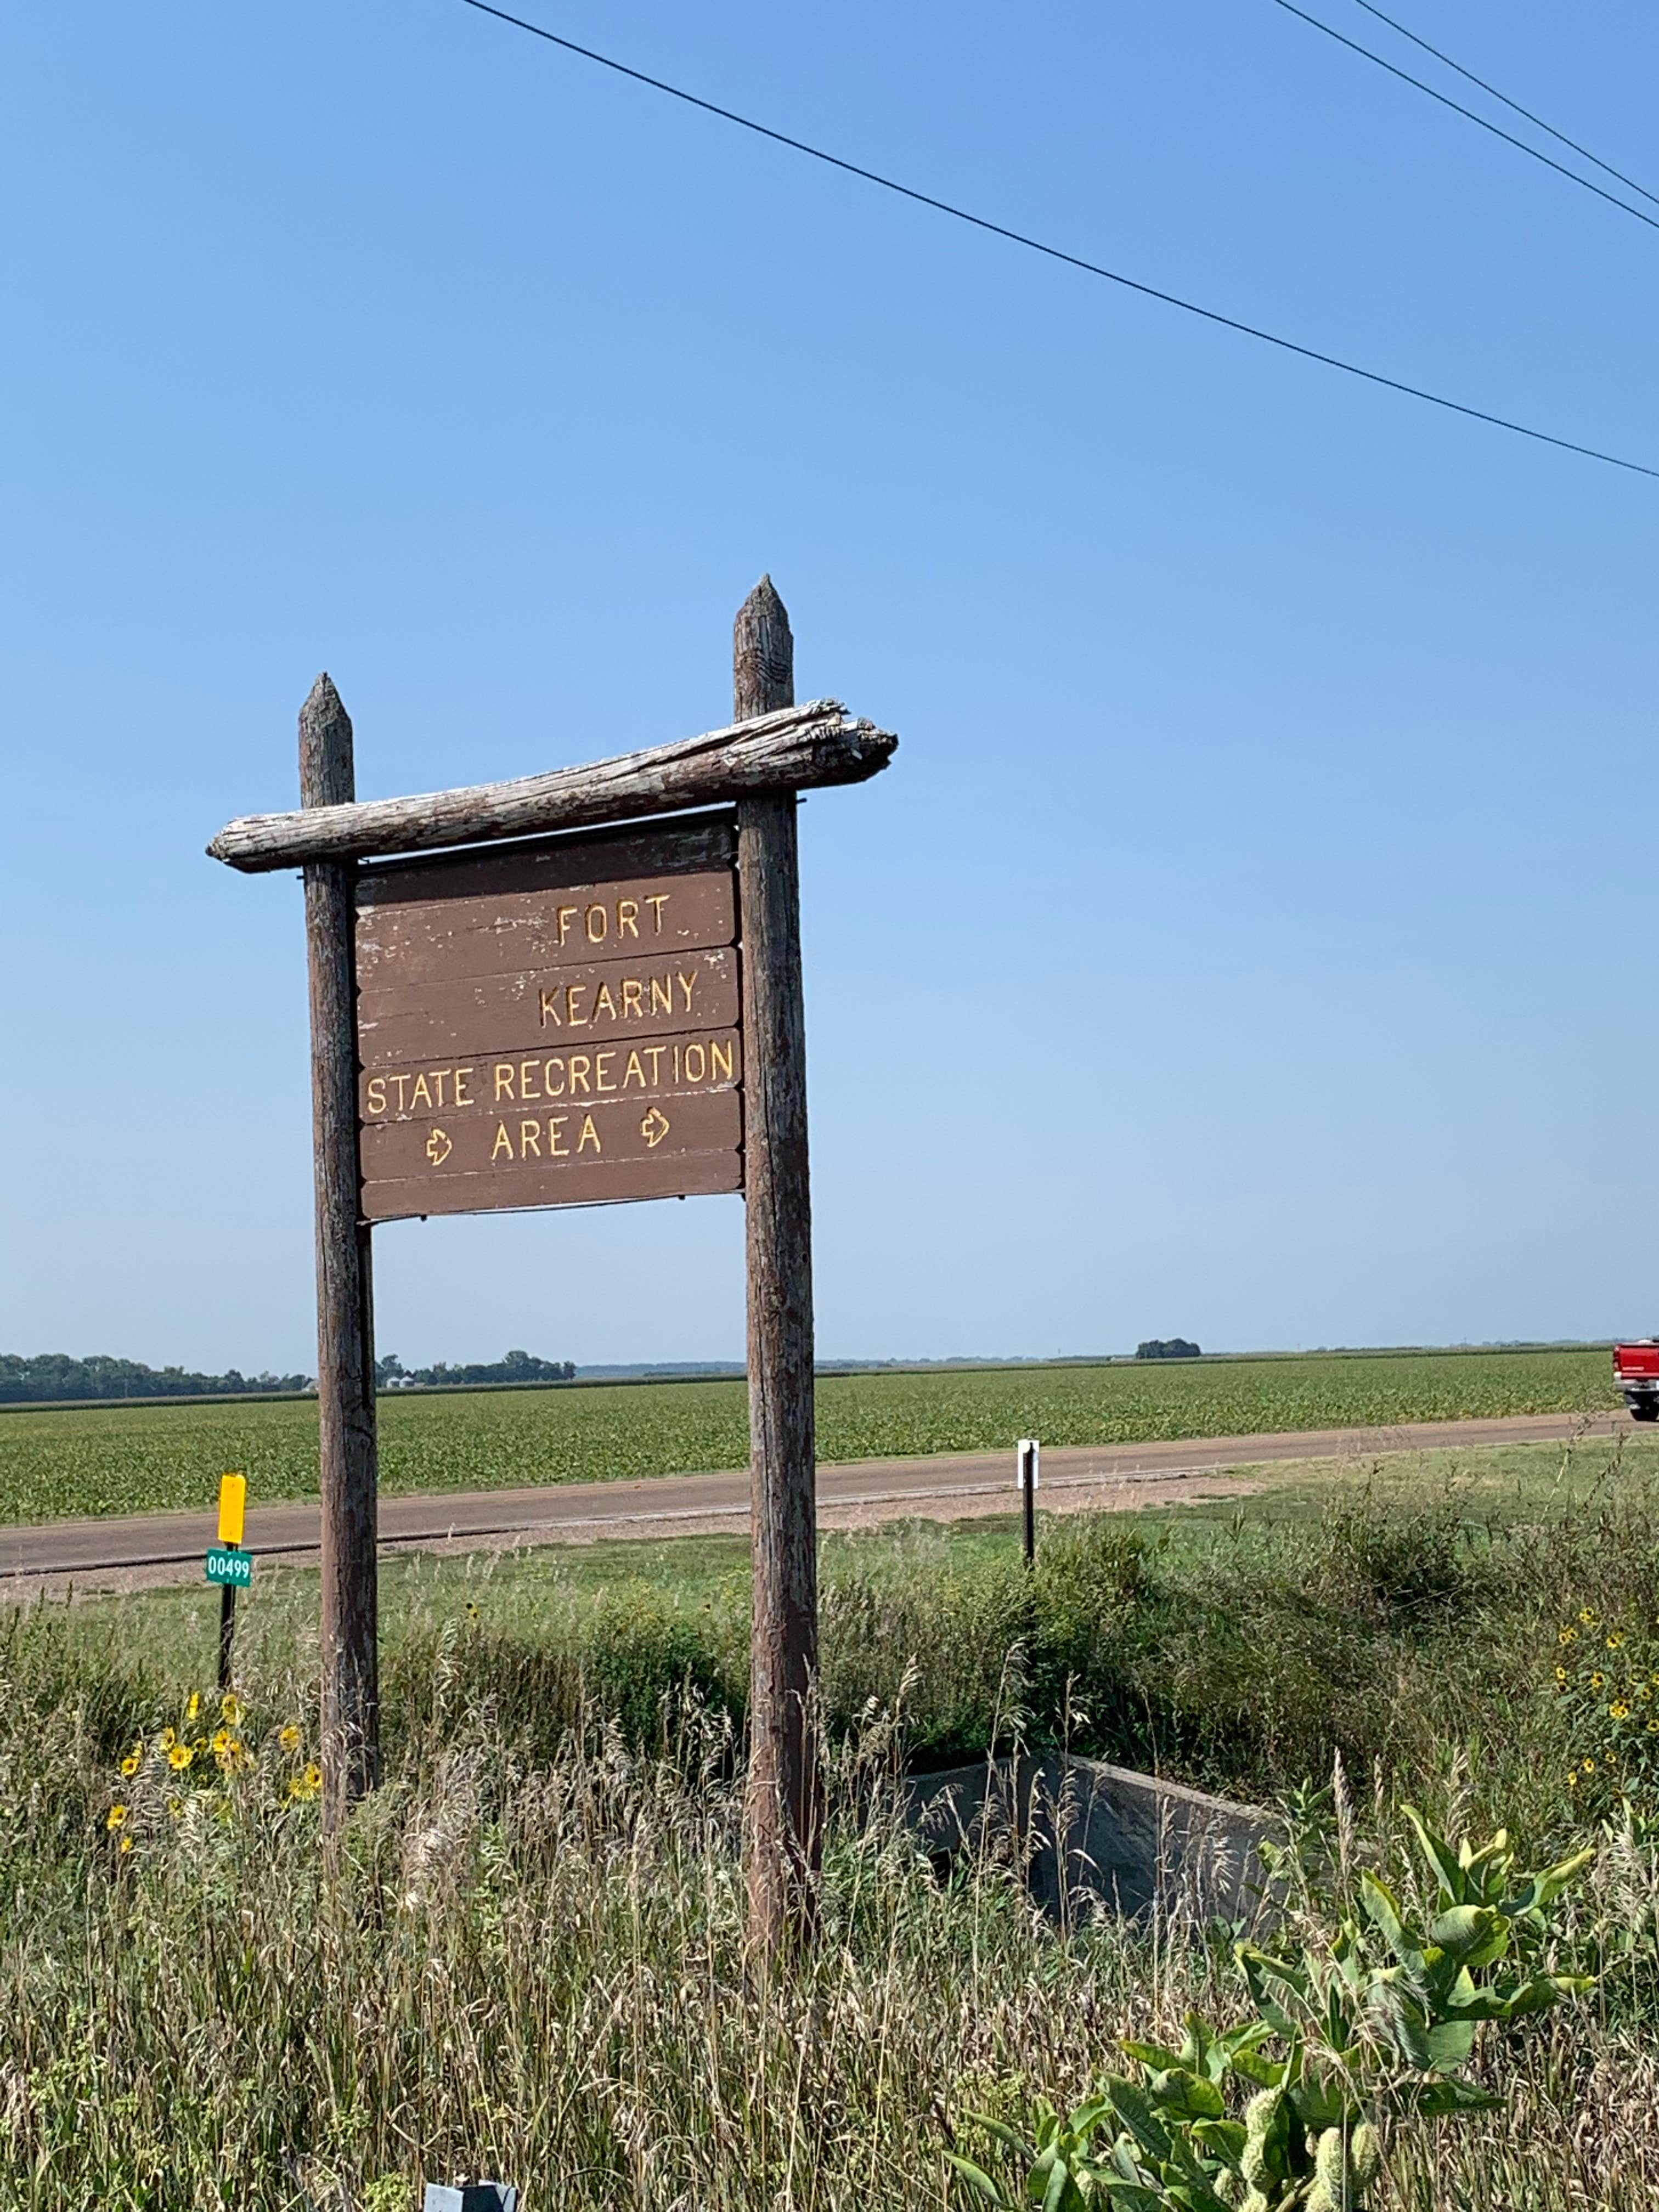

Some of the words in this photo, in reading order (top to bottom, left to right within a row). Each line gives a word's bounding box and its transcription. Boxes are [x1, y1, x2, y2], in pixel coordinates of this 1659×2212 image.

[557, 894, 670, 947] FORT
[539, 970, 698, 1028] KEARNY
[366, 1068, 475, 1114] STATE
[494, 1039, 734, 1102] RECREATION
[491, 1114, 602, 1160] AREA
[208, 1555, 249, 1578] 00499
